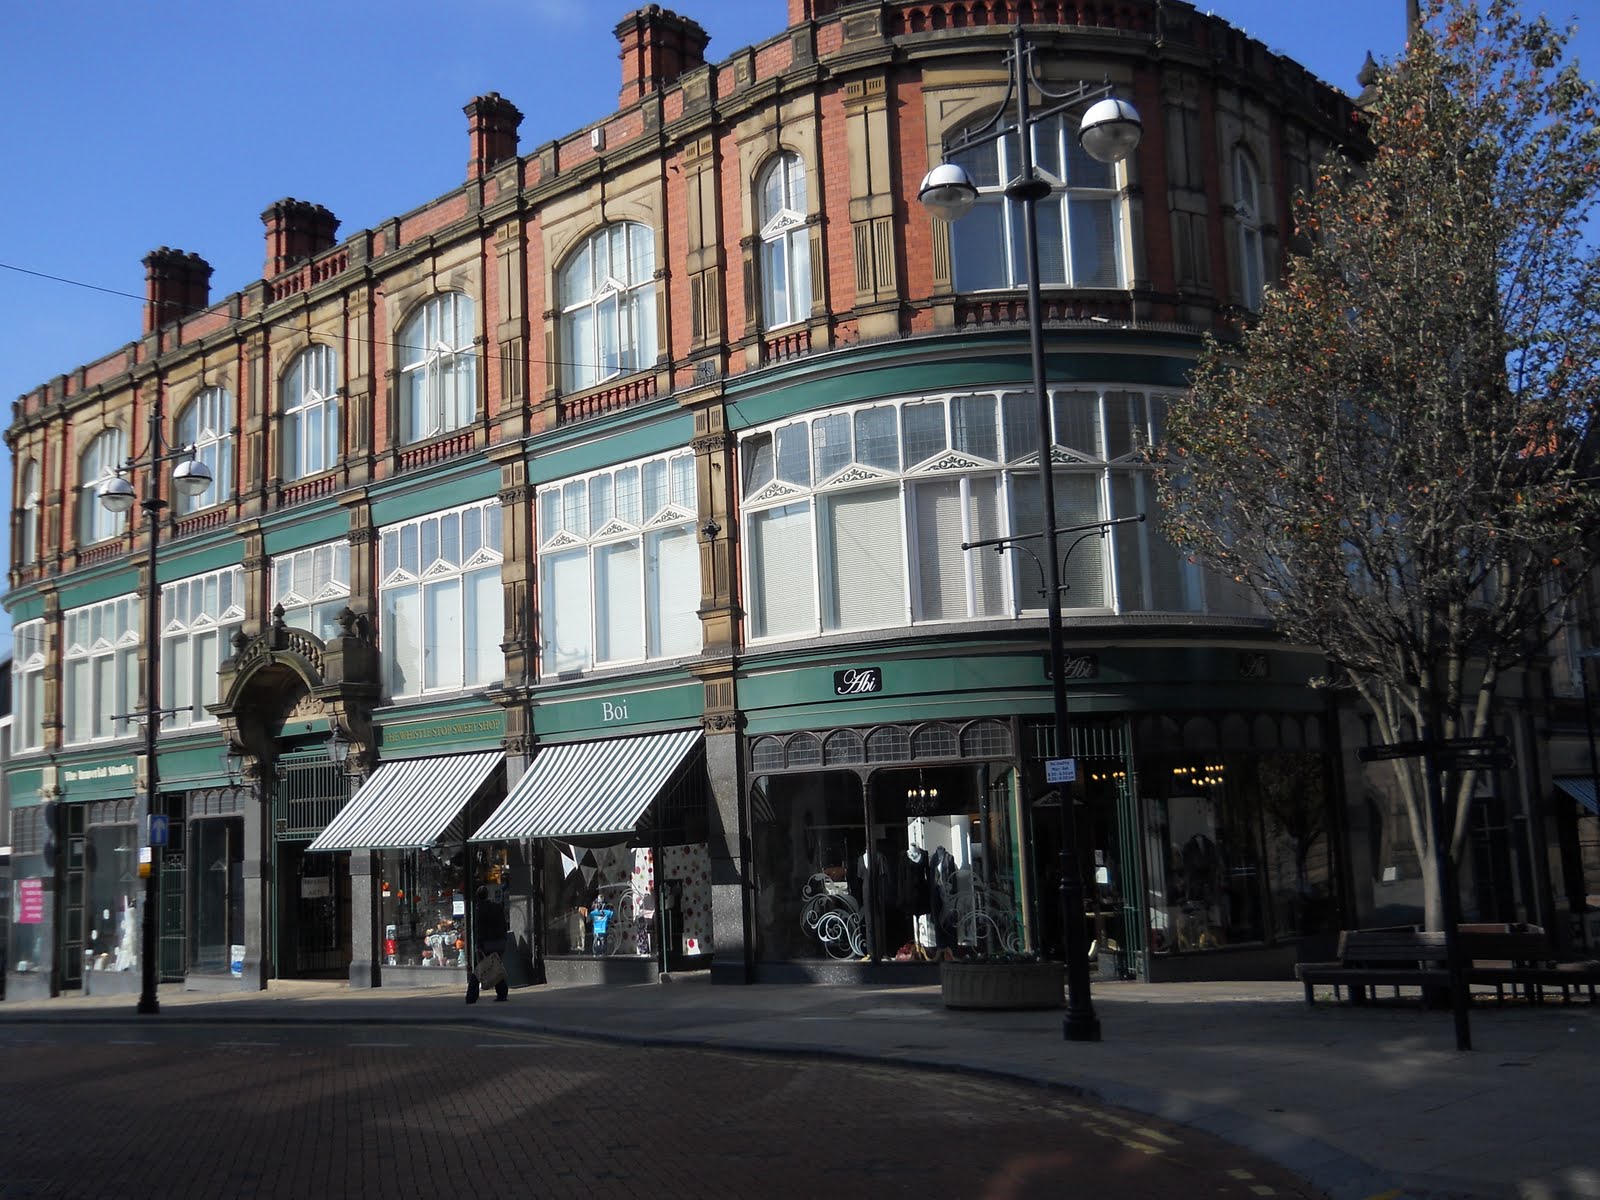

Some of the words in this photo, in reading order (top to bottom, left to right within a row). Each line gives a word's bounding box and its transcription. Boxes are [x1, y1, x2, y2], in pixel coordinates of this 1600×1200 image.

[837, 669, 876, 694] Abi
[602, 699, 628, 721] Boi
[384, 733, 399, 743] THE
[399, 728, 432, 741] WHISTLE
[432, 726, 453, 737] STOP
[453, 720, 478, 736] SWEET
[479, 719, 500, 731] SHOP
